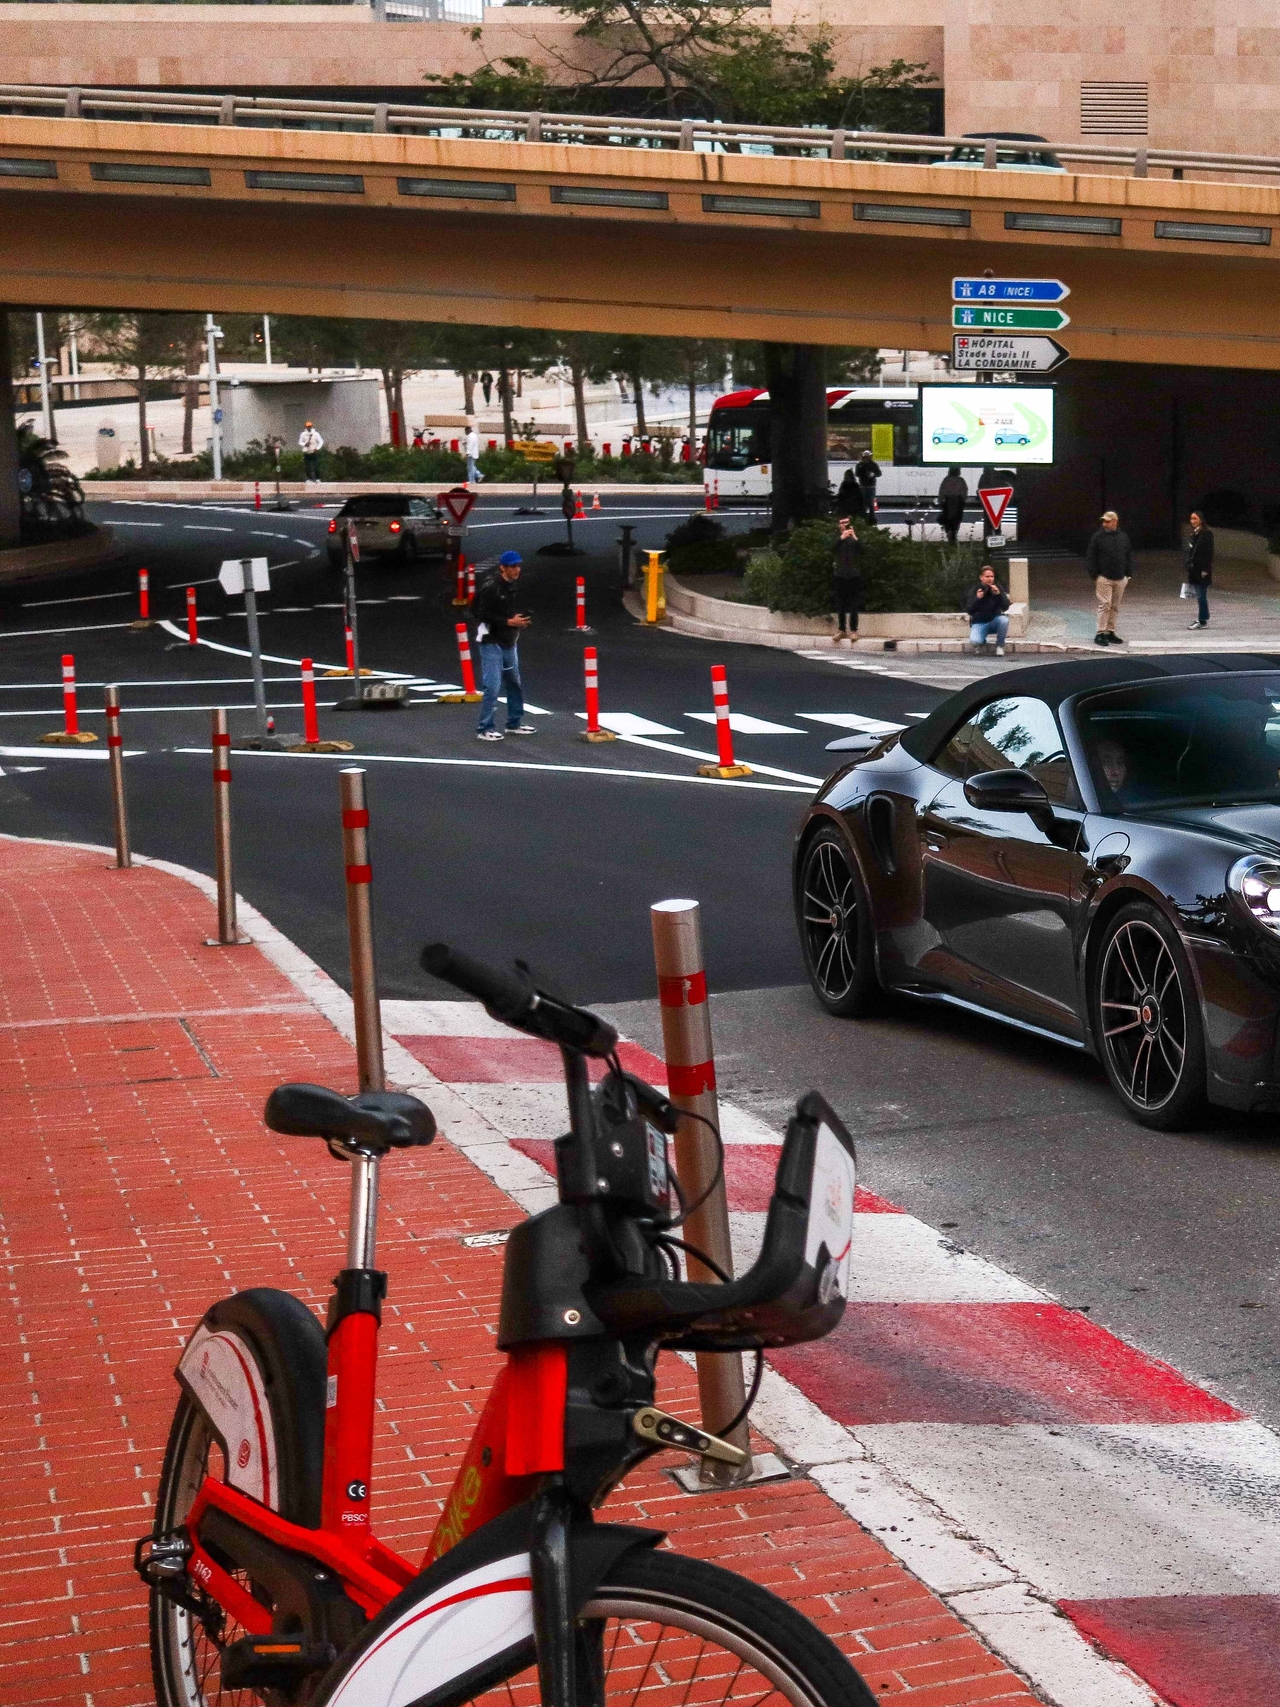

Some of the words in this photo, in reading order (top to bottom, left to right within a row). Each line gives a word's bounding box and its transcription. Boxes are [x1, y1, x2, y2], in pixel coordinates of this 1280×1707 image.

[978, 285, 996, 296] A8
[1003, 287, 1034, 297] (NICE)
[983, 312, 1014, 324] NICE
[971, 338, 1015, 349] HÔPITAL
[958, 350, 987, 358] Stade
[991, 350, 1017, 359] Louis
[958, 359, 971, 368] LA
[975, 359, 1037, 369] CONDAMINE
